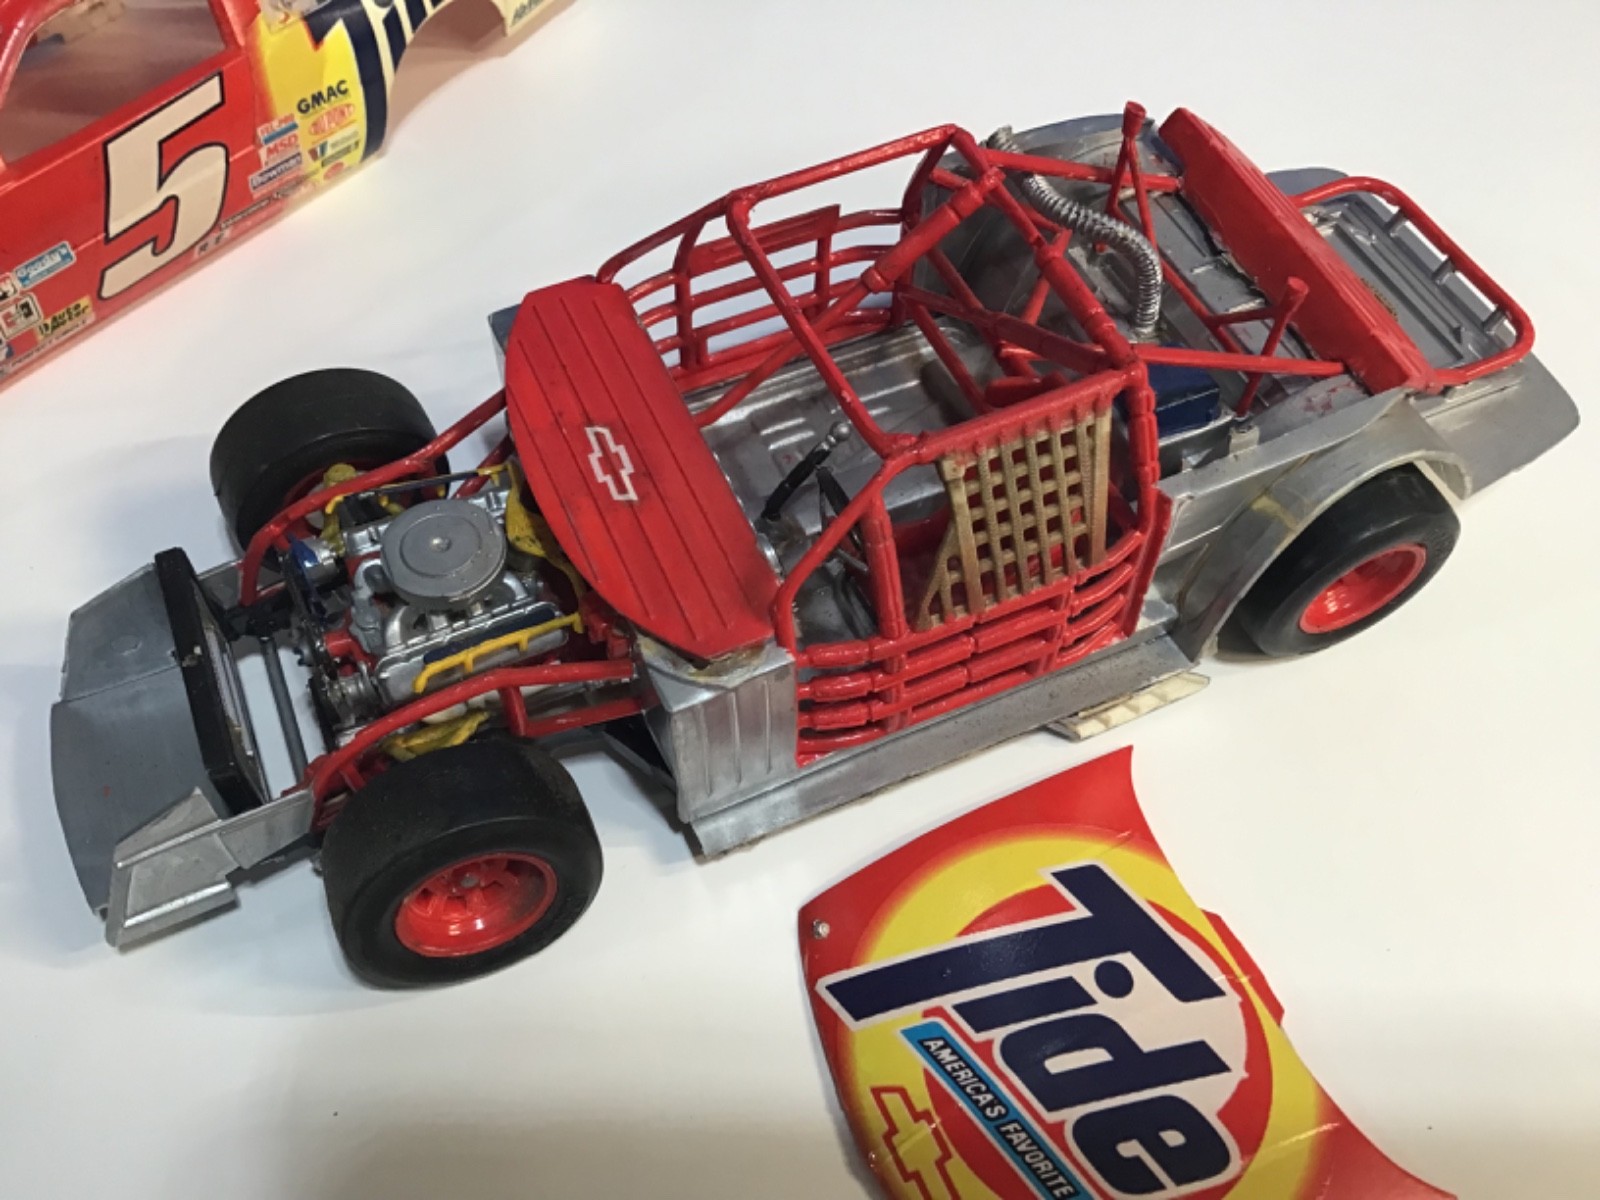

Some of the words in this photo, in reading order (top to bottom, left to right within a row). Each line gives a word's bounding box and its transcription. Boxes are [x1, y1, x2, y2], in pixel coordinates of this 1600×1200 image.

[98, 70, 229, 300] 5
[296, 80, 349, 114] GMAC
[824, 863, 1233, 1196] Tide
[922, 1038, 1006, 1118] AMERICA'S
[999, 1121, 1076, 1198] FAVORITE
